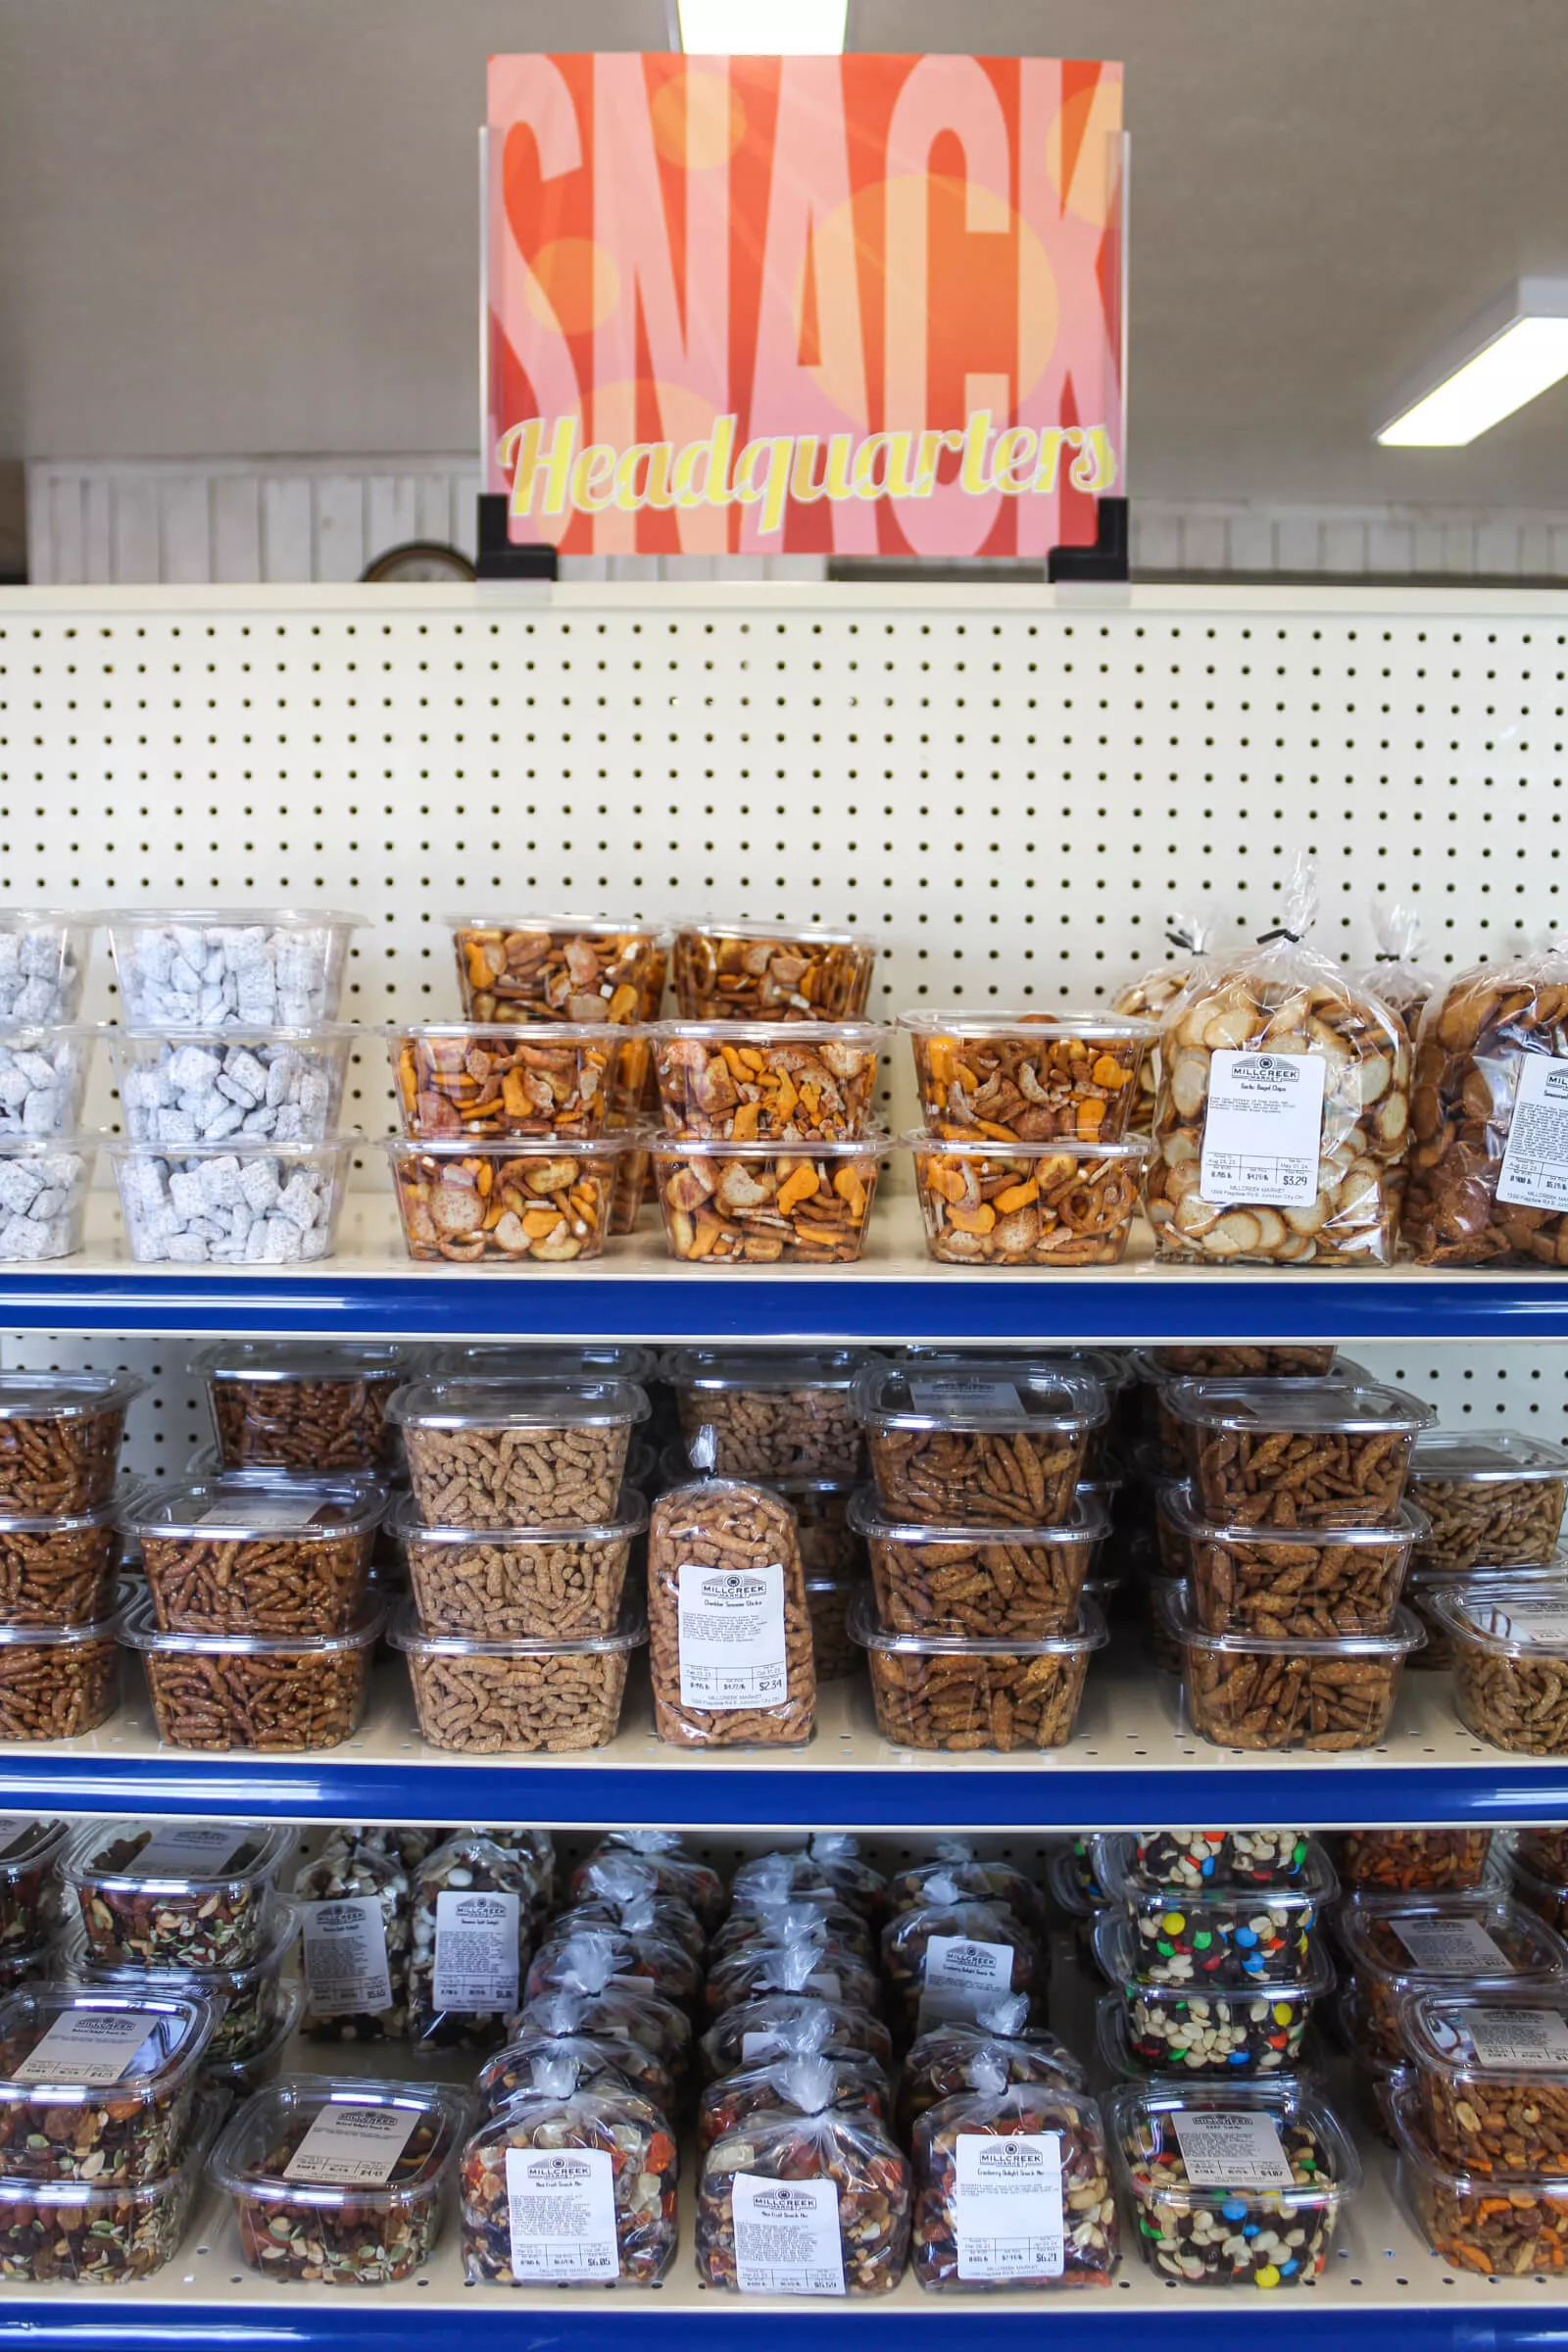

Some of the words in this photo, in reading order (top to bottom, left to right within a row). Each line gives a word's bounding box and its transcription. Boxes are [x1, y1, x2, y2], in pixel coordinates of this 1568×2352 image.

[487, 52, 1124, 557] SNACK
[497, 410, 1118, 536] Headquarters
[1233, 1067, 1297, 1078] MILLCREEK
[1283, 1175, 1307, 1186] $3.29
[704, 1586, 764, 1594] MILLCREEK
[760, 1679, 782, 1691] $2.34
[947, 1952, 995, 1965] MILLCREEK
[1036, 2253, 1056, 2263] $6.21
